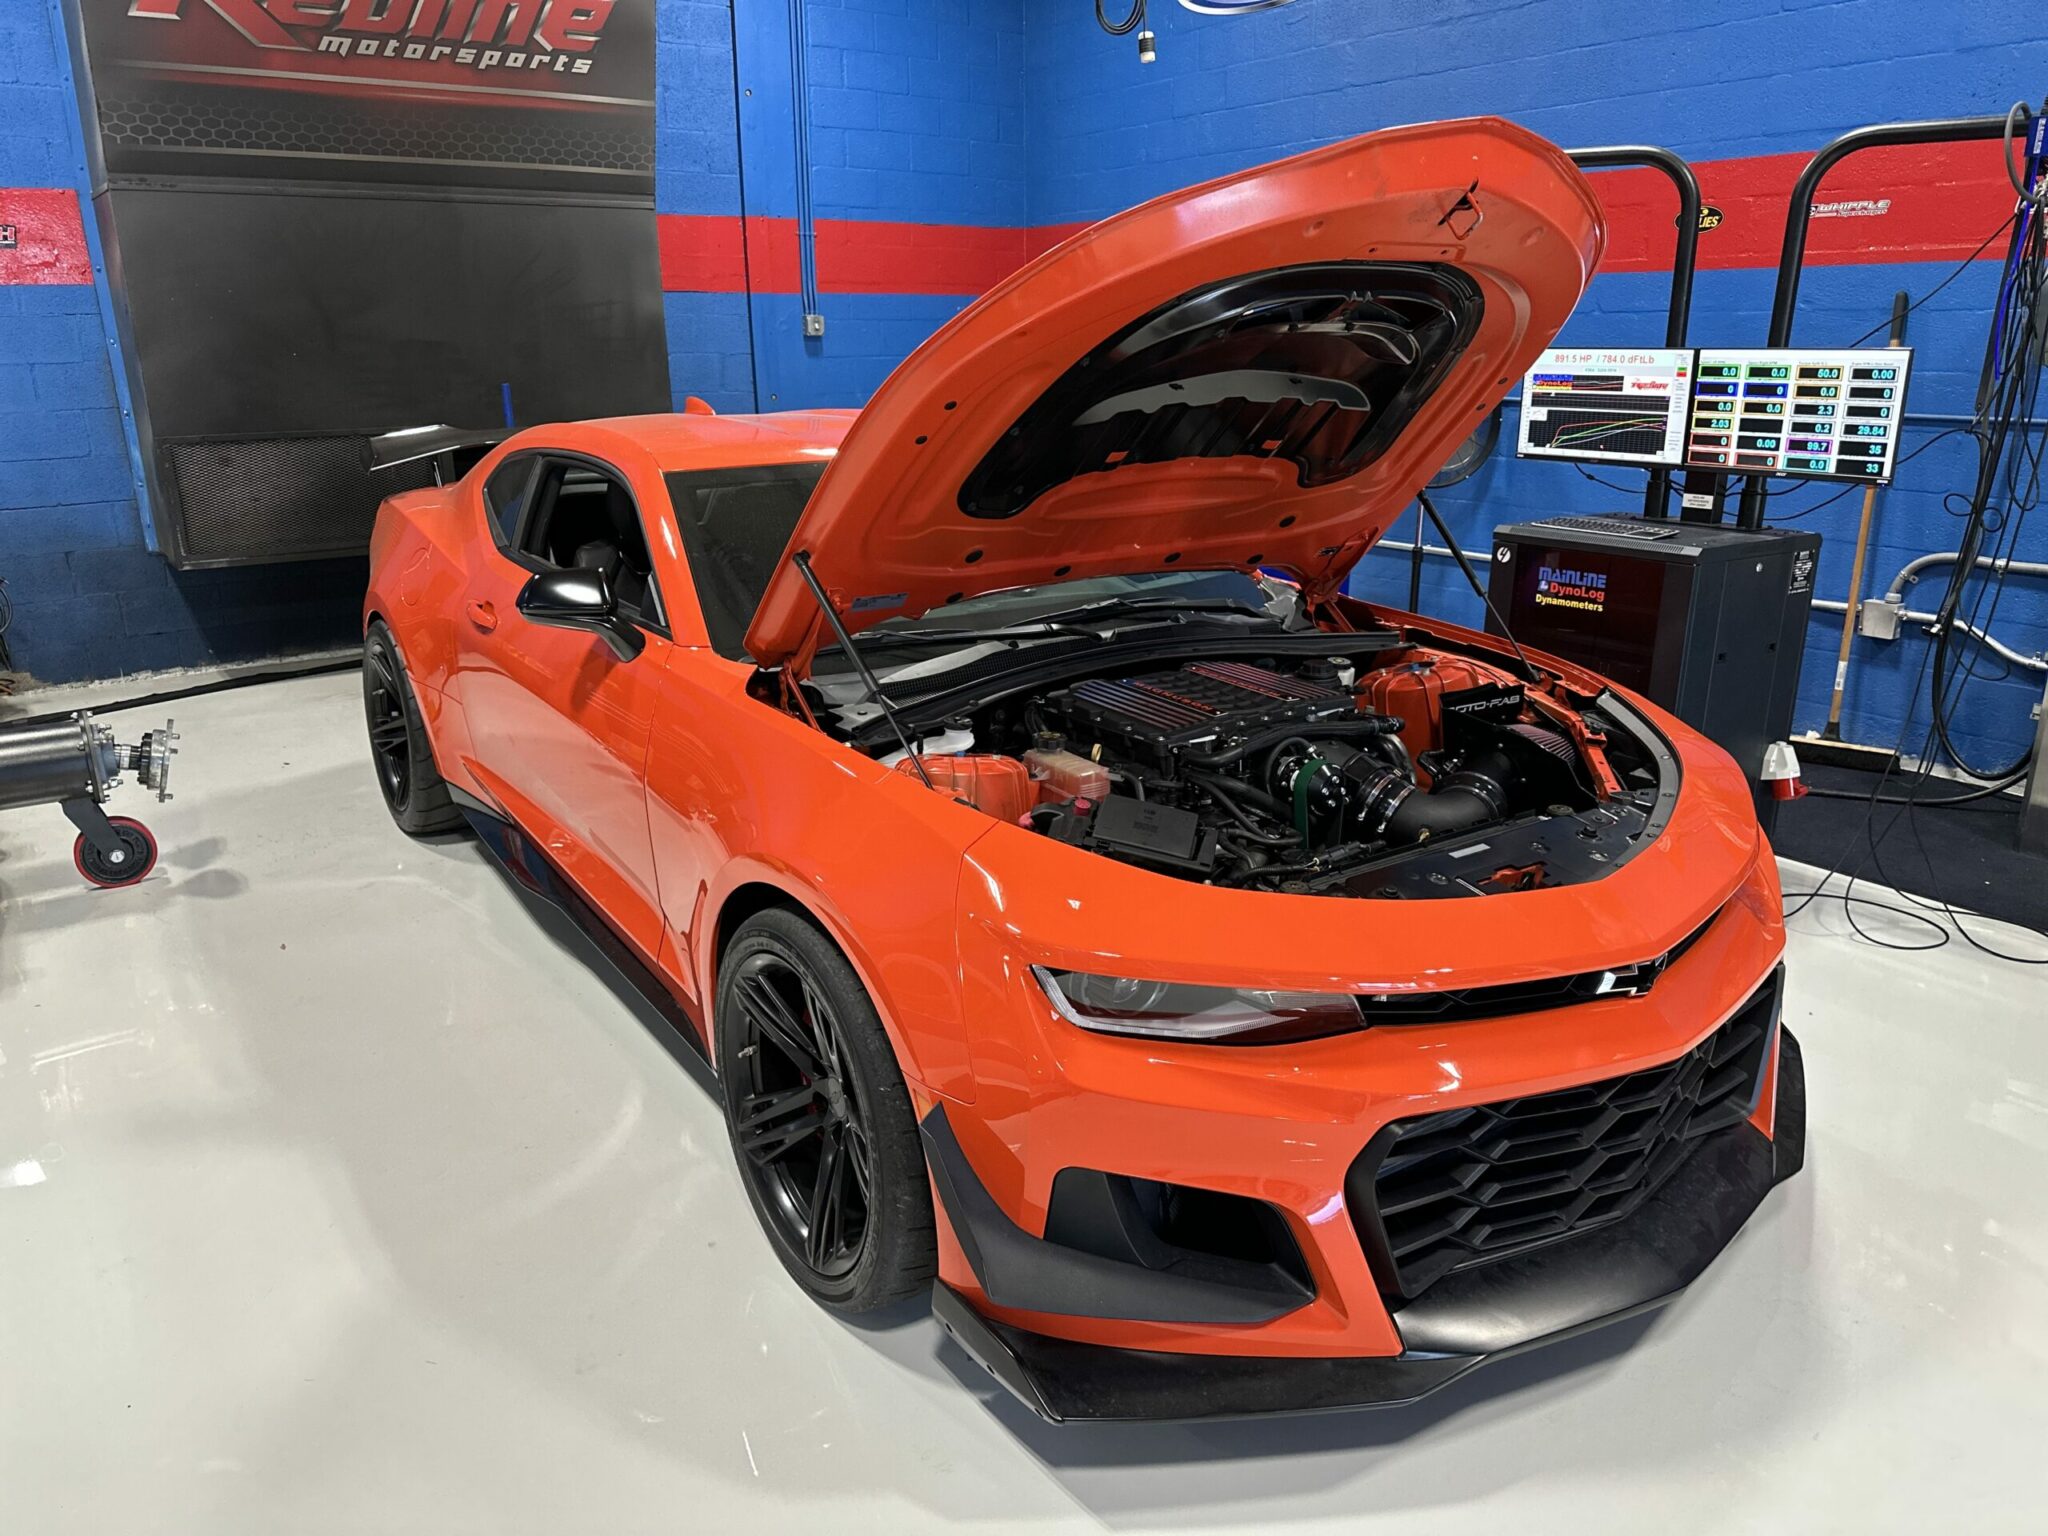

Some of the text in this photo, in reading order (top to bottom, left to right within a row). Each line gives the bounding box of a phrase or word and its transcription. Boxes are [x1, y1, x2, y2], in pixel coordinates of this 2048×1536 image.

[317, 35, 594, 74] motorsports
[1819, 200, 1890, 211] WHIPPLE
[1554, 355, 1577, 364] 891.5
[1579, 355, 1592, 364] HP
[1602, 355, 1626, 364] 784.0
[1627, 355, 1655, 365] dFtLb
[1722, 367, 1737, 376] 0.0
[1771, 368, 1786, 377] 0.0
[1872, 370, 1894, 379] 0.00
[1727, 385, 1734, 394] 0
[1777, 386, 1784, 395] 0
[1820, 387, 1836, 397] 0.0
[1883, 389, 1890, 398] 0
[1718, 402, 1732, 411] 0.0
[1766, 404, 1781, 413] 0.0
[1817, 406, 1833, 415] 2.3
[1880, 408, 1888, 417] 0
[1814, 424, 1830, 433] 0.2
[1857, 426, 1884, 436] 29.84
[1720, 436, 1727, 445] 0
[1756, 439, 1776, 448] 0.00
[1868, 445, 1882, 455] 35
[1718, 454, 1725, 463] 0
[1766, 457, 1773, 466] 0
[1809, 460, 1825, 469] 0.0
[1866, 463, 1879, 473] 33
[1549, 582, 1606, 602] DynoLog
[1535, 593, 1604, 612] Dynamometers
[1448, 695, 1520, 713] OTO-FAB
